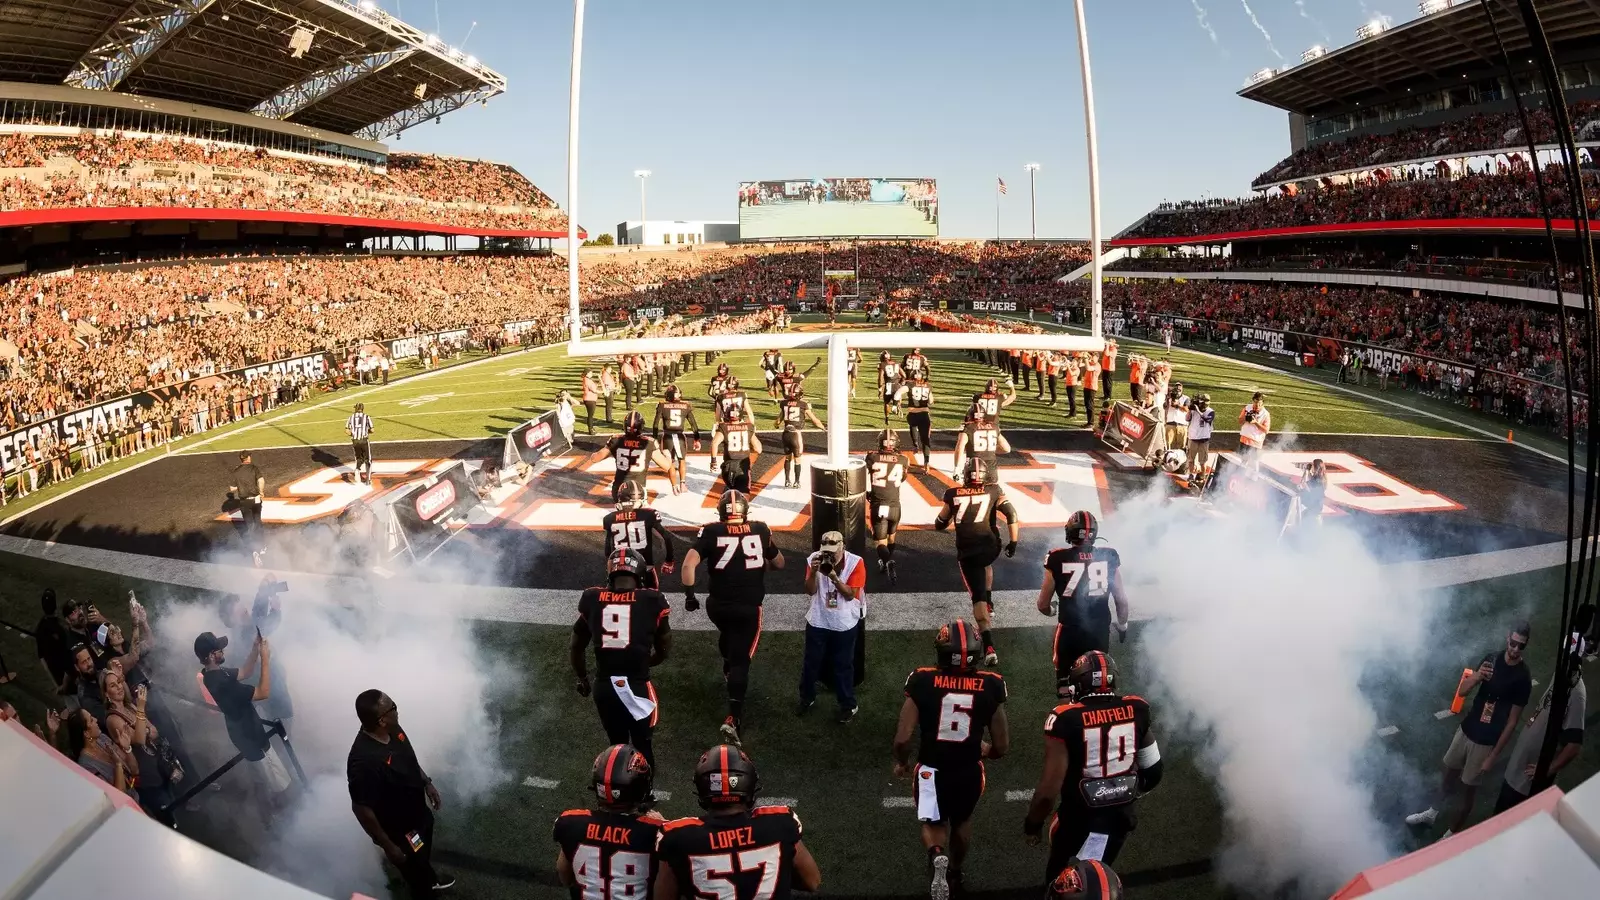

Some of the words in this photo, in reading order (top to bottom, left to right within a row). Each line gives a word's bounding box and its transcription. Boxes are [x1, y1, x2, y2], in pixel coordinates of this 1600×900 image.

[636, 307, 664, 319] BEAVERS
[973, 301, 1017, 311] BEAVERS
[670, 409, 681, 426] 5
[784, 405, 801, 422] 12
[728, 431, 750, 451] 81
[973, 430, 998, 452] 66
[616, 447, 646, 472] 63
[872, 462, 903, 488] 24
[956, 487, 985, 495] GONZALEZ
[615, 511, 637, 521] MILLER
[953, 494, 990, 523] 77
[611, 521, 648, 549] 20
[714, 534, 764, 570] 79
[1061, 561, 1109, 597] 78
[599, 592, 637, 602] NEWELL
[601, 604, 631, 649] 9
[934, 675, 984, 691] MARTINEZ
[936, 692, 974, 742] 6
[1081, 705, 1134, 726] CHATFIELD
[1082, 722, 1137, 778] 10
[586, 823, 632, 846] BLACK
[708, 827, 756, 850] LOPEZ
[572, 844, 650, 900] 48
[688, 841, 781, 900] 57
